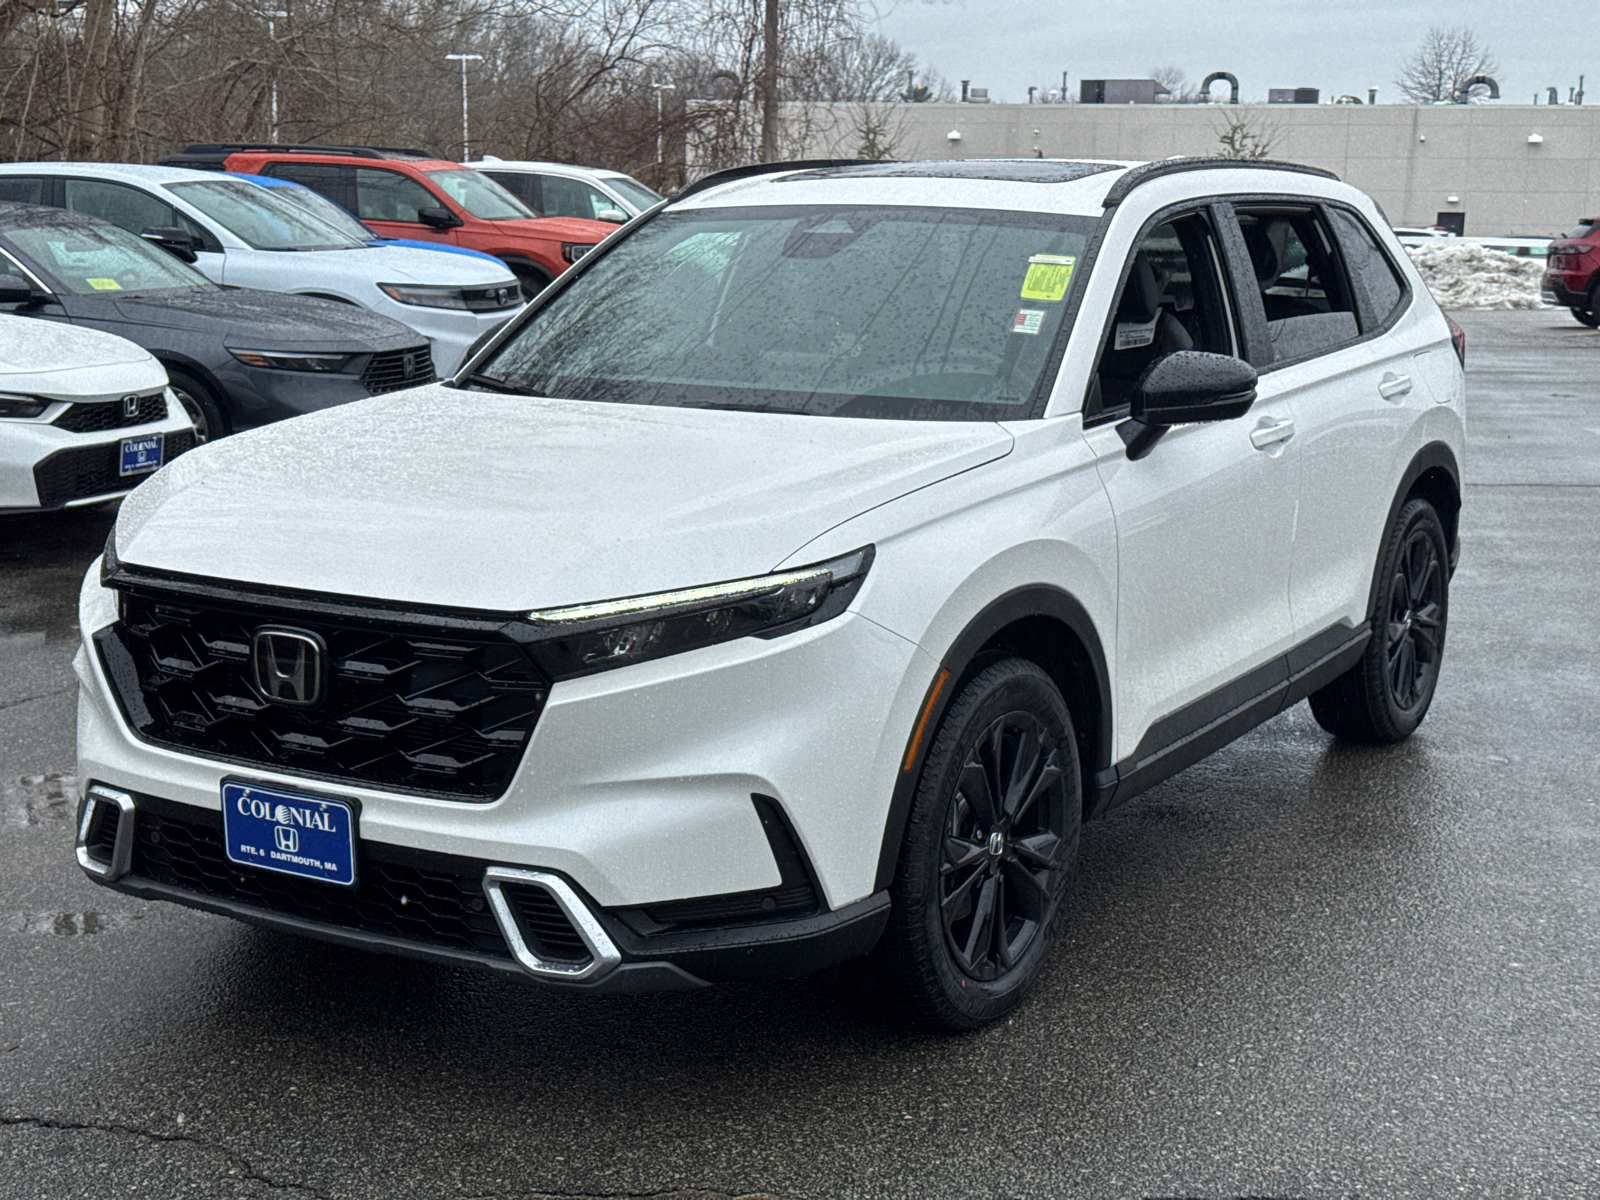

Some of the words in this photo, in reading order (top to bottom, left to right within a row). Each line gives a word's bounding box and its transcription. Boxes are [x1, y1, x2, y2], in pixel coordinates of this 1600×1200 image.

[237, 797, 336, 832] COLONIAL
[240, 844, 258, 855] RTE.
[270, 851, 323, 869] DARTMOUTH,
[324, 862, 338, 871] MA
